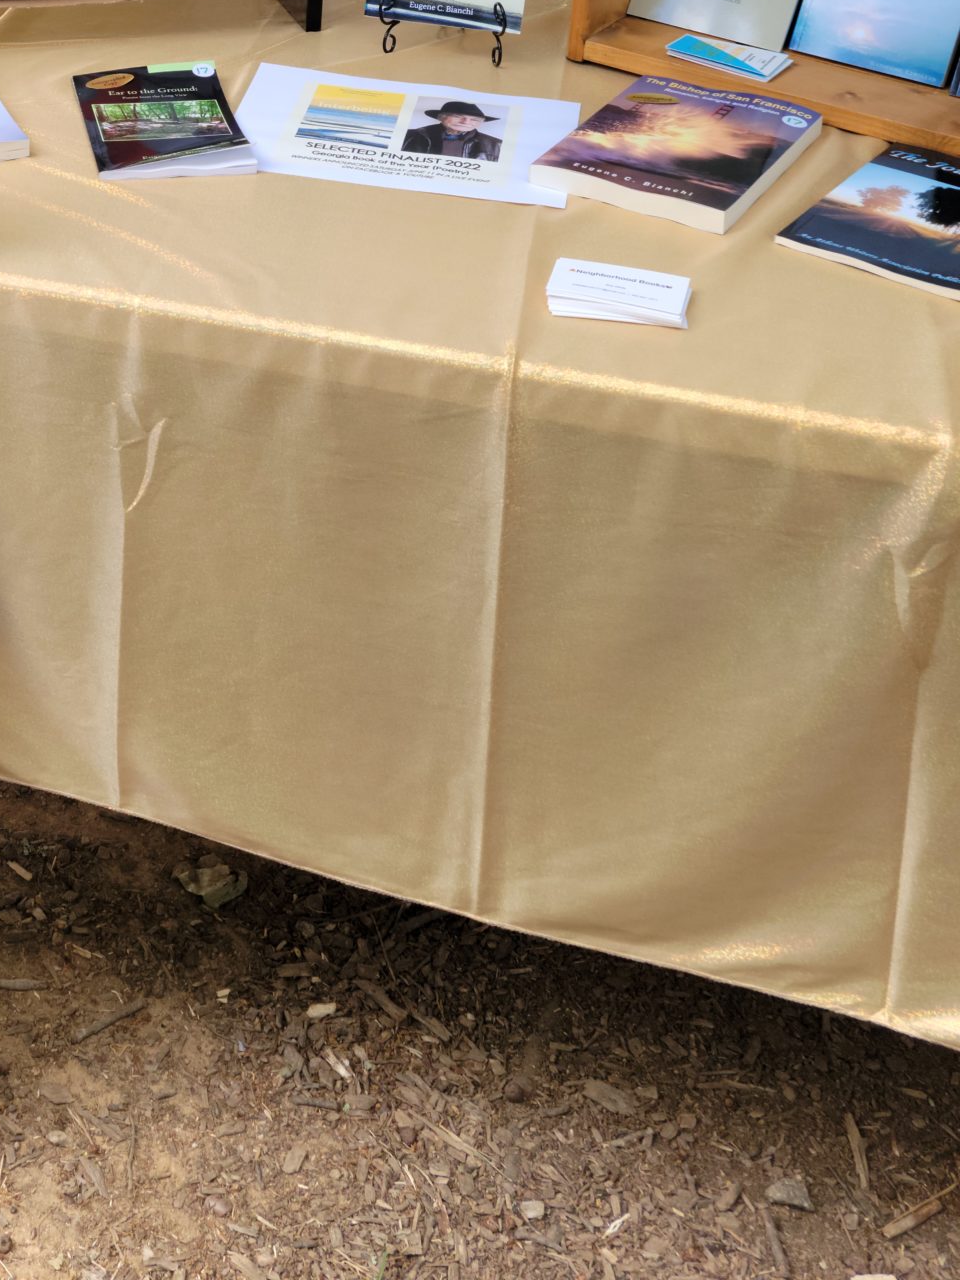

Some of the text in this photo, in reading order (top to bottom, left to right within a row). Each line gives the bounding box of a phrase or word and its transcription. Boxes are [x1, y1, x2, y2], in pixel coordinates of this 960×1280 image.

[409, 1, 474, 16] Eugene C. Bianchi
[645, 77, 666, 87] The
[669, 81, 710, 96] Bishop
[726, 94, 751, 102] San
[752, 97, 813, 120] Francisco
[748, 104, 781, 116] Religion
[305, 141, 482, 171] SELECTED FINALIST 2022
[311, 150, 350, 160] Georgia
[432, 165, 470, 176] (Poetry)
[889, 150, 928, 164] The
[573, 162, 694, 197] Eugene C. Bianchi
